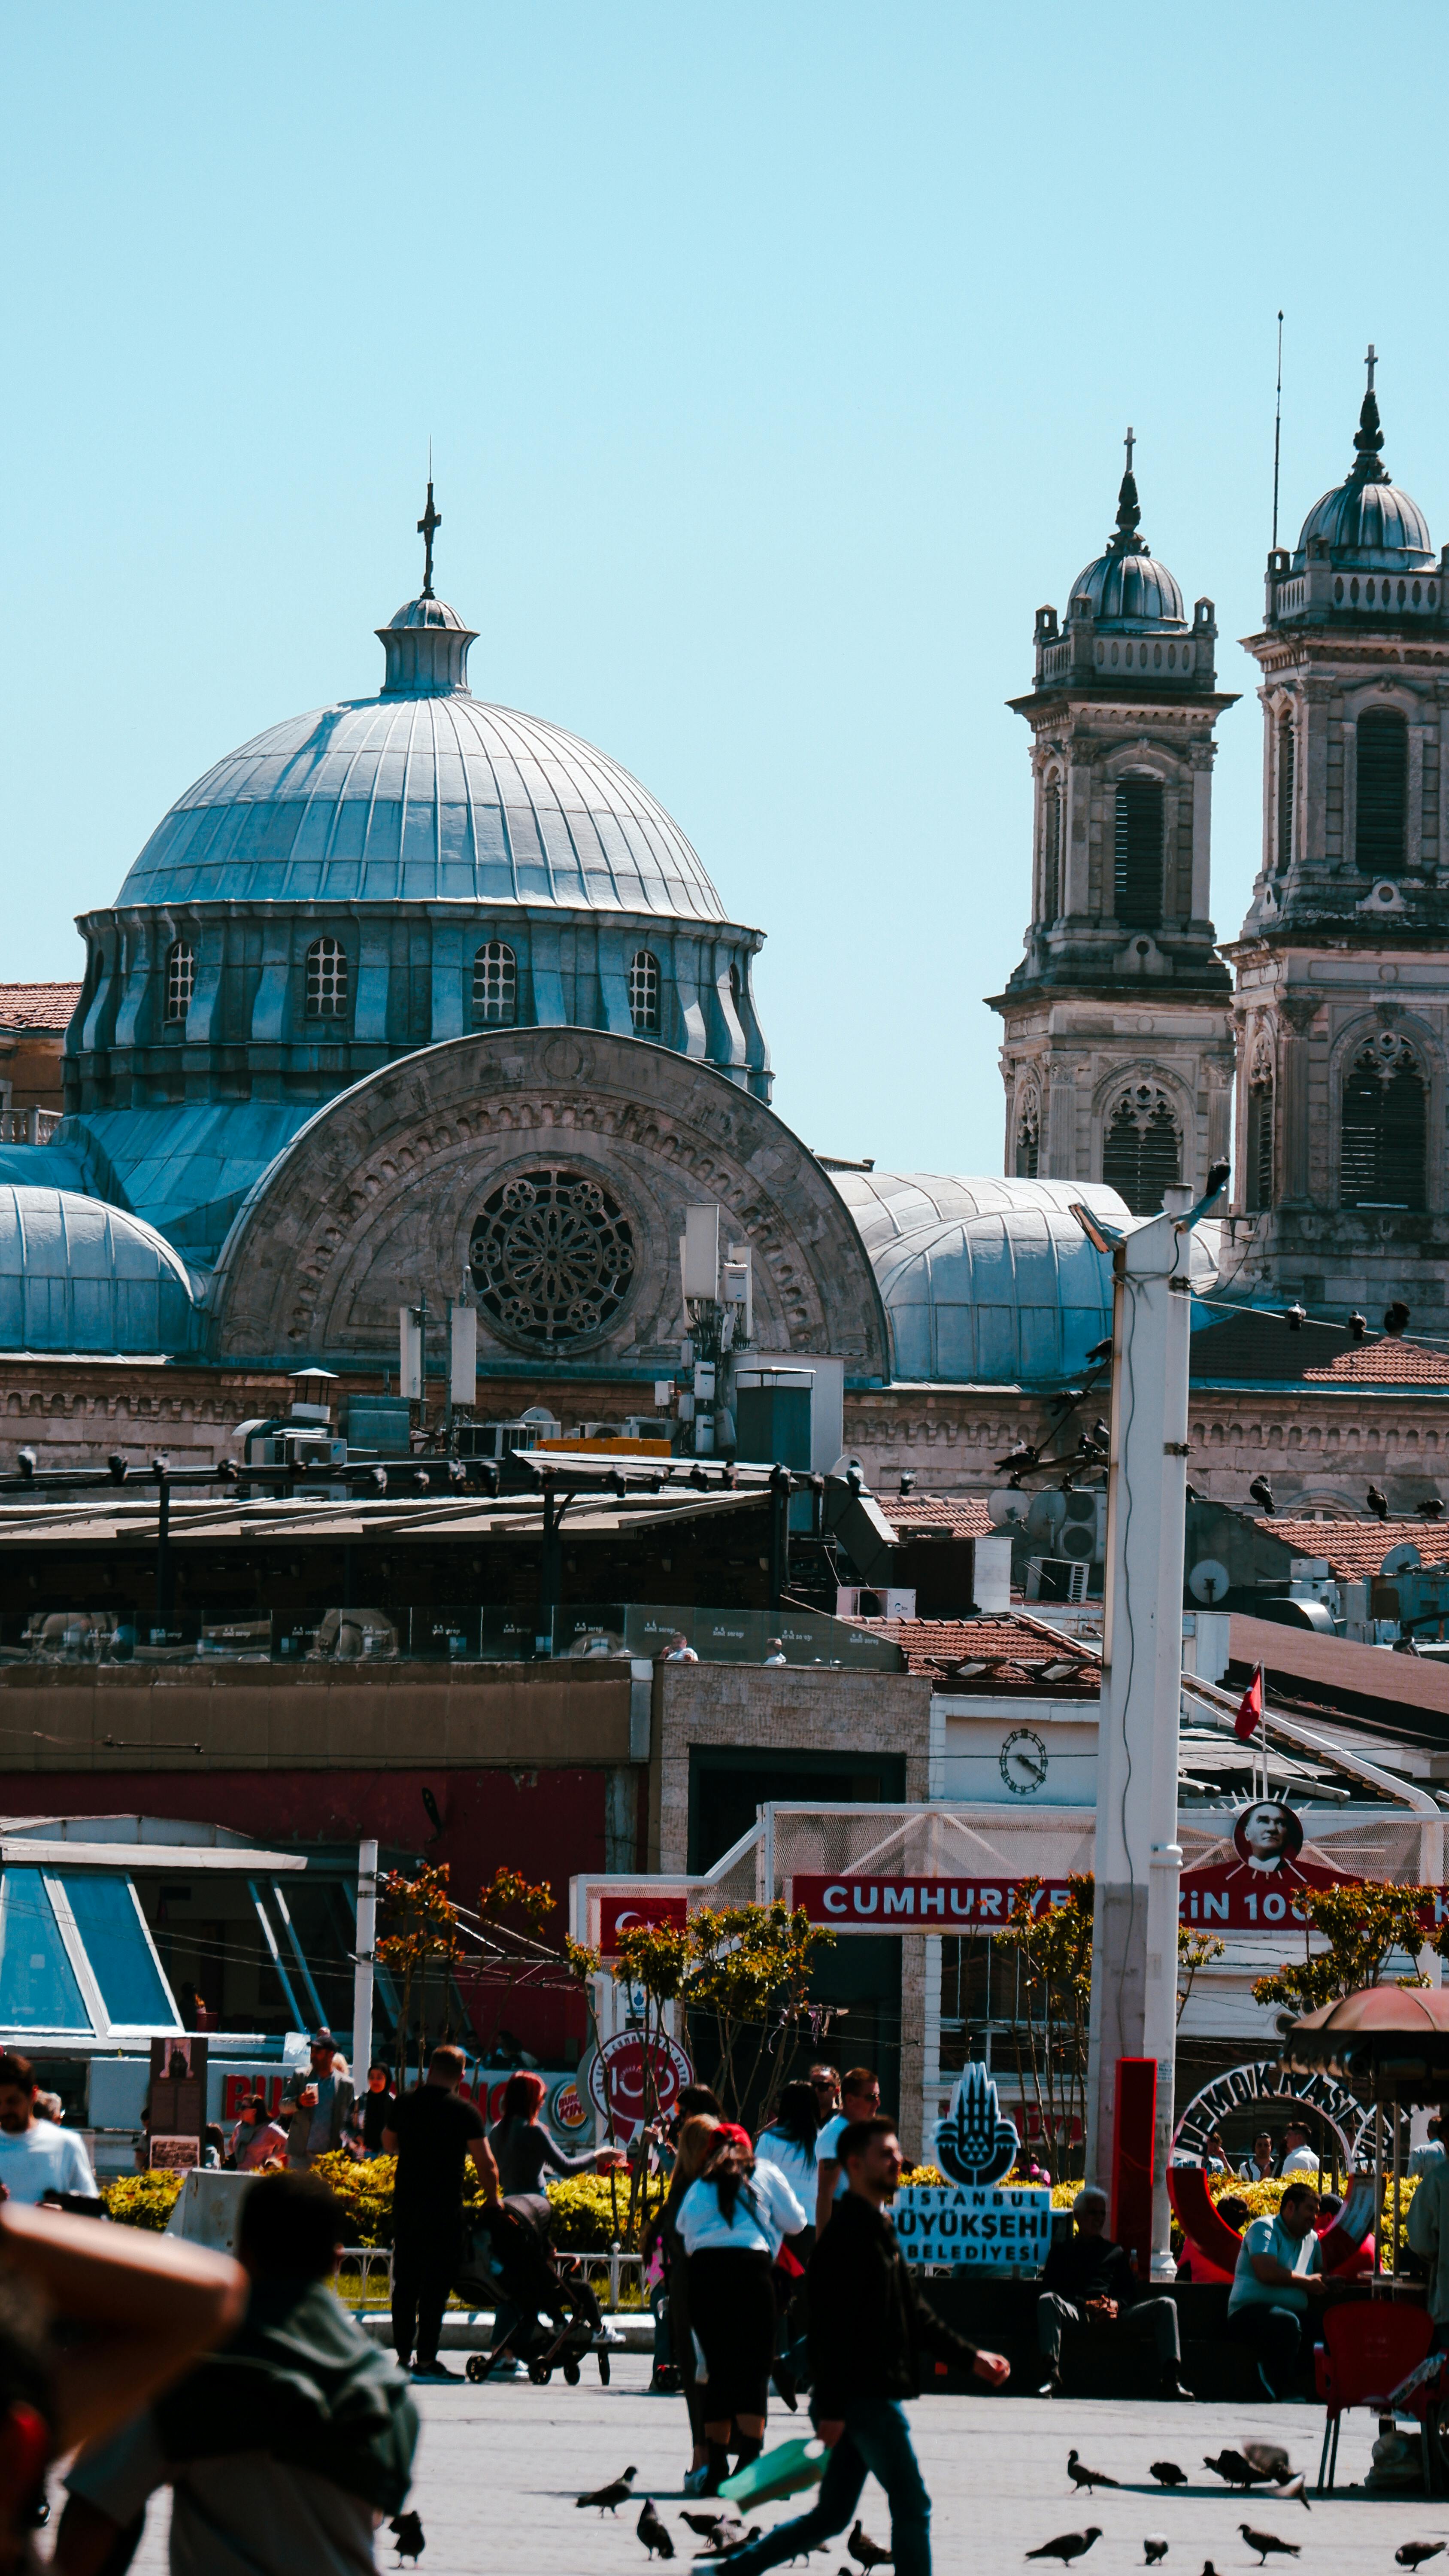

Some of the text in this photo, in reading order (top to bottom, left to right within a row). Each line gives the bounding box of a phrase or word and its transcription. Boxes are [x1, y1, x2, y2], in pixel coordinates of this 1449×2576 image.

[559, 2103, 582, 2121] KIN
[908, 2189, 1040, 2206] İSTANBUL
[891, 2209, 1060, 2240] ÜYÜKŞEHİ
[907, 2243, 1039, 2260] BELEDİYESİ
